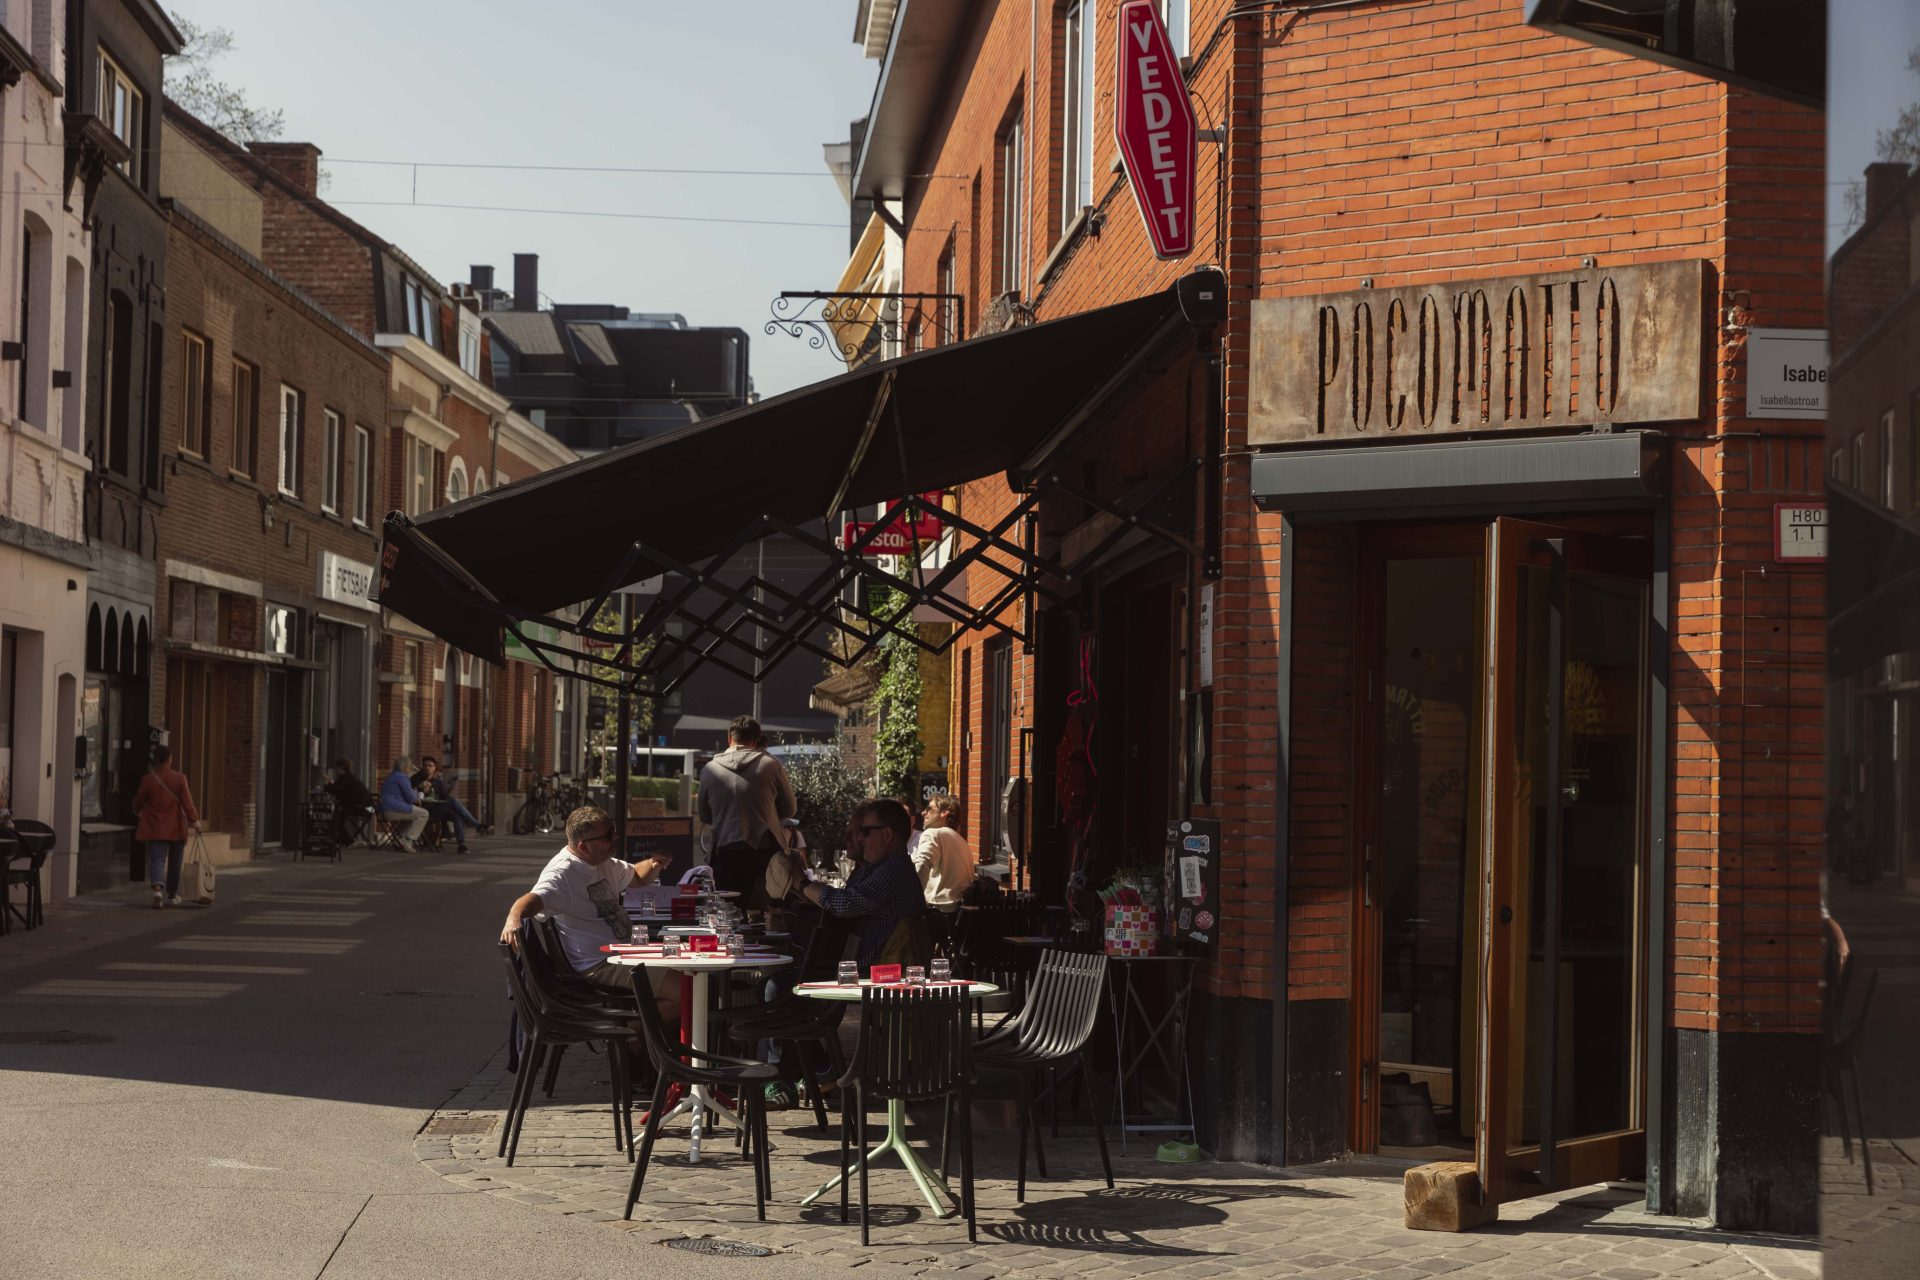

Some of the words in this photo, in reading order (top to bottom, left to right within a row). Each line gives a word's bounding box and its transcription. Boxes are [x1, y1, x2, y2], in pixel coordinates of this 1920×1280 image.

[1130, 20, 1182, 239] VEDETT
[1317, 276, 1621, 433] POCOMATTO
[1760, 394, 1820, 407] Isabellastroat
